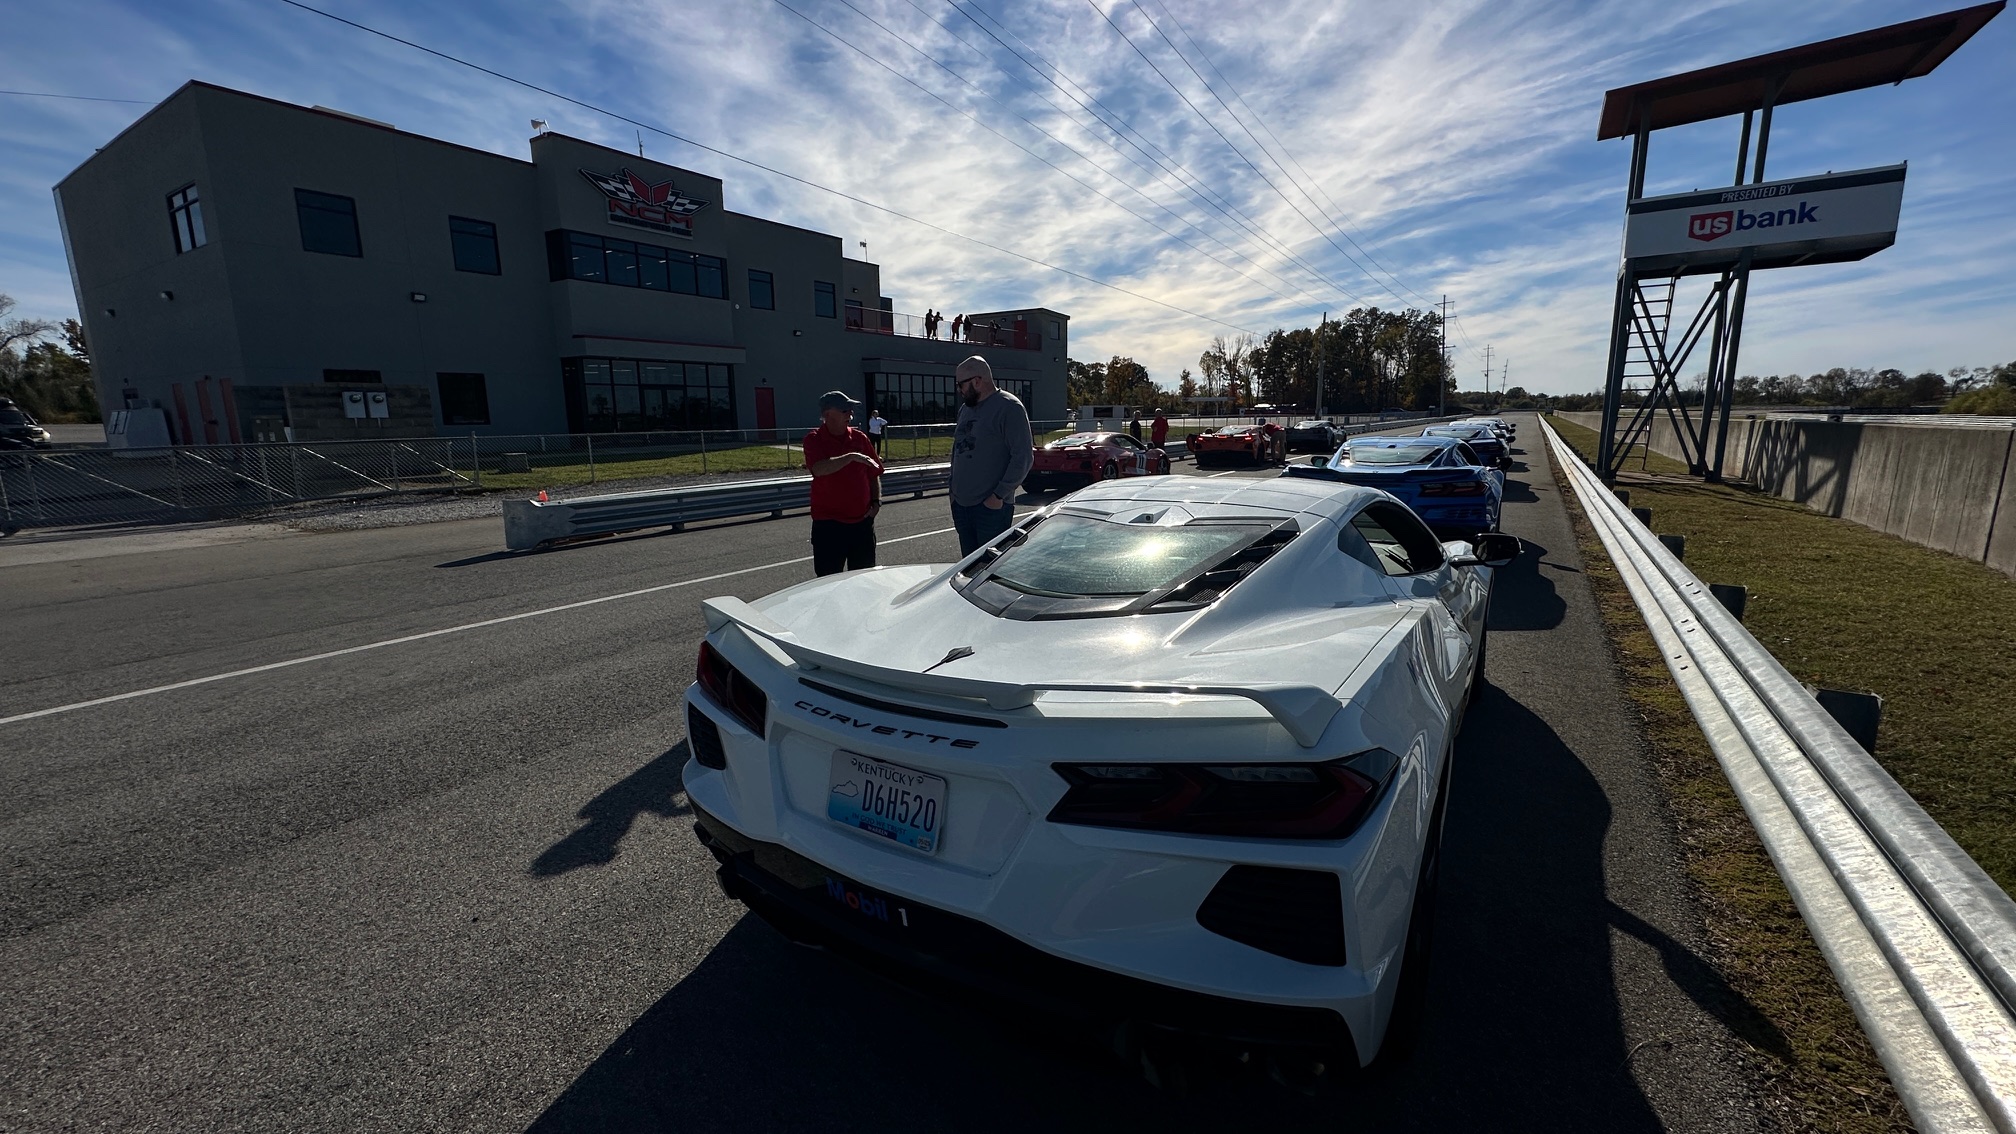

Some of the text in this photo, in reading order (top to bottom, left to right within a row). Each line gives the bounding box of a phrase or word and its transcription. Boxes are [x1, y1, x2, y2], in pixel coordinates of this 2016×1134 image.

[1721, 183, 1795, 202] PRESENTED BY
[609, 199, 693, 229] NCM
[794, 700, 980, 749] CORVETTE
[857, 761, 915, 786] KENTUCKY
[861, 779, 937, 832] D6H520
[851, 812, 907, 835] IN GOD WE TRUST
[825, 876, 908, 926] Mobil 1
